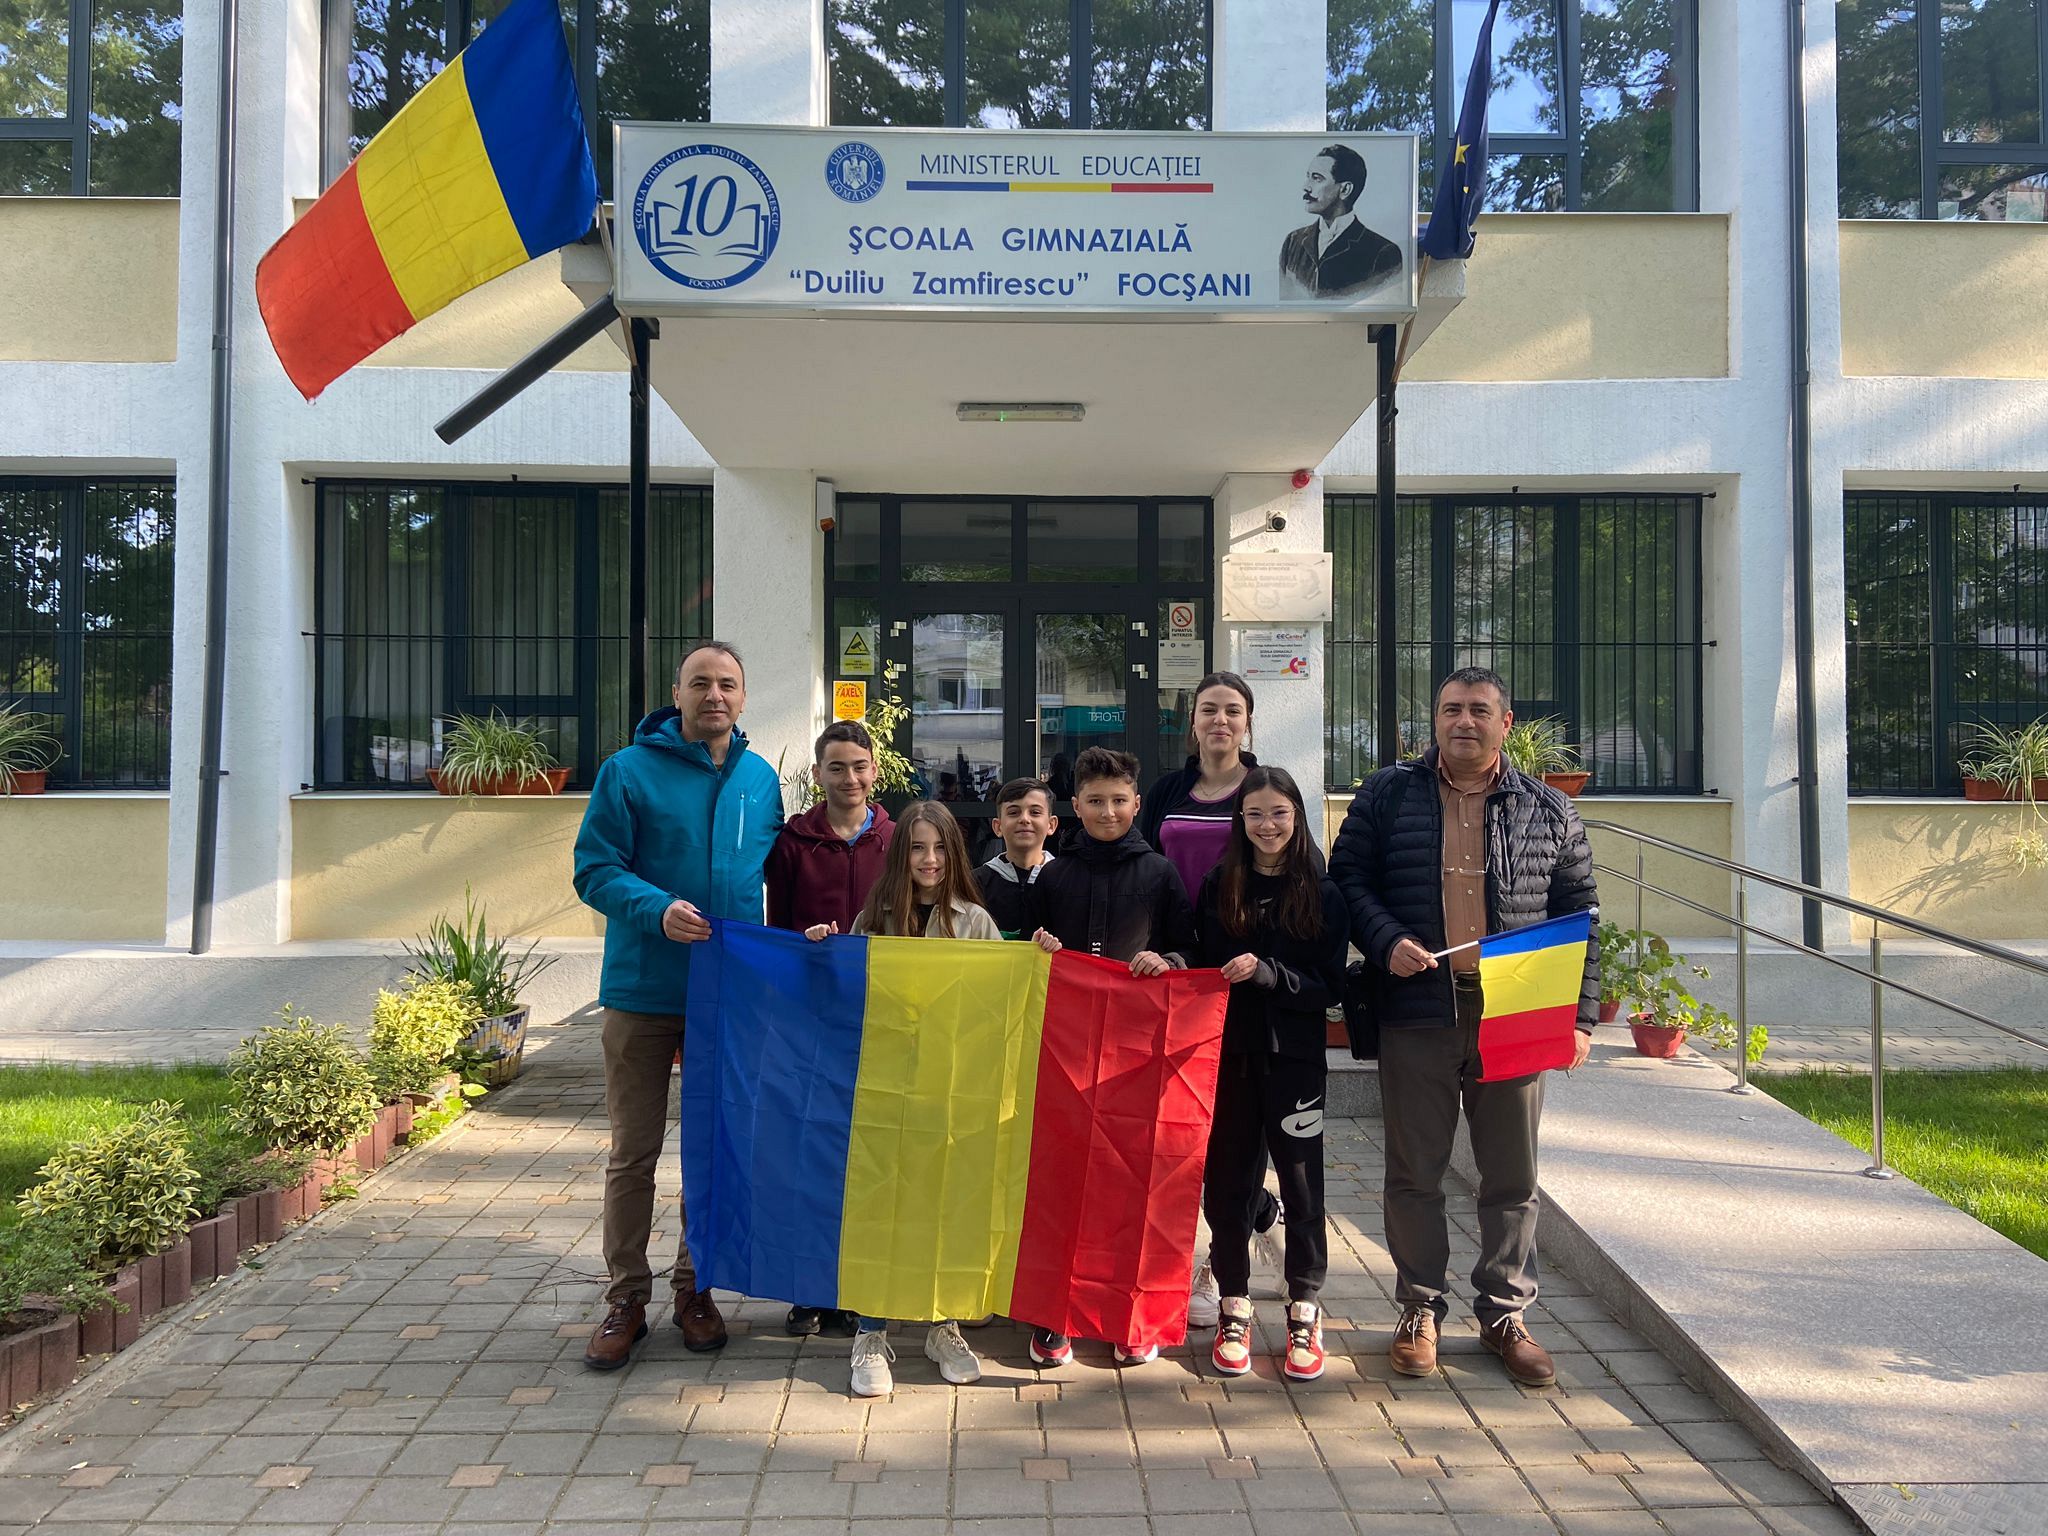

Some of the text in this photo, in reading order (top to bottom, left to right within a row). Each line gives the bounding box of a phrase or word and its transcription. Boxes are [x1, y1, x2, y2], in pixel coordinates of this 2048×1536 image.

[830, 144, 880, 166] GUVERNUL
[920, 154, 1060, 176] MINISTERUL
[671, 174, 737, 237] 10
[1002, 223, 1193, 253] GIMNAZIALĂ
[840, 687, 860, 698] AXEL
